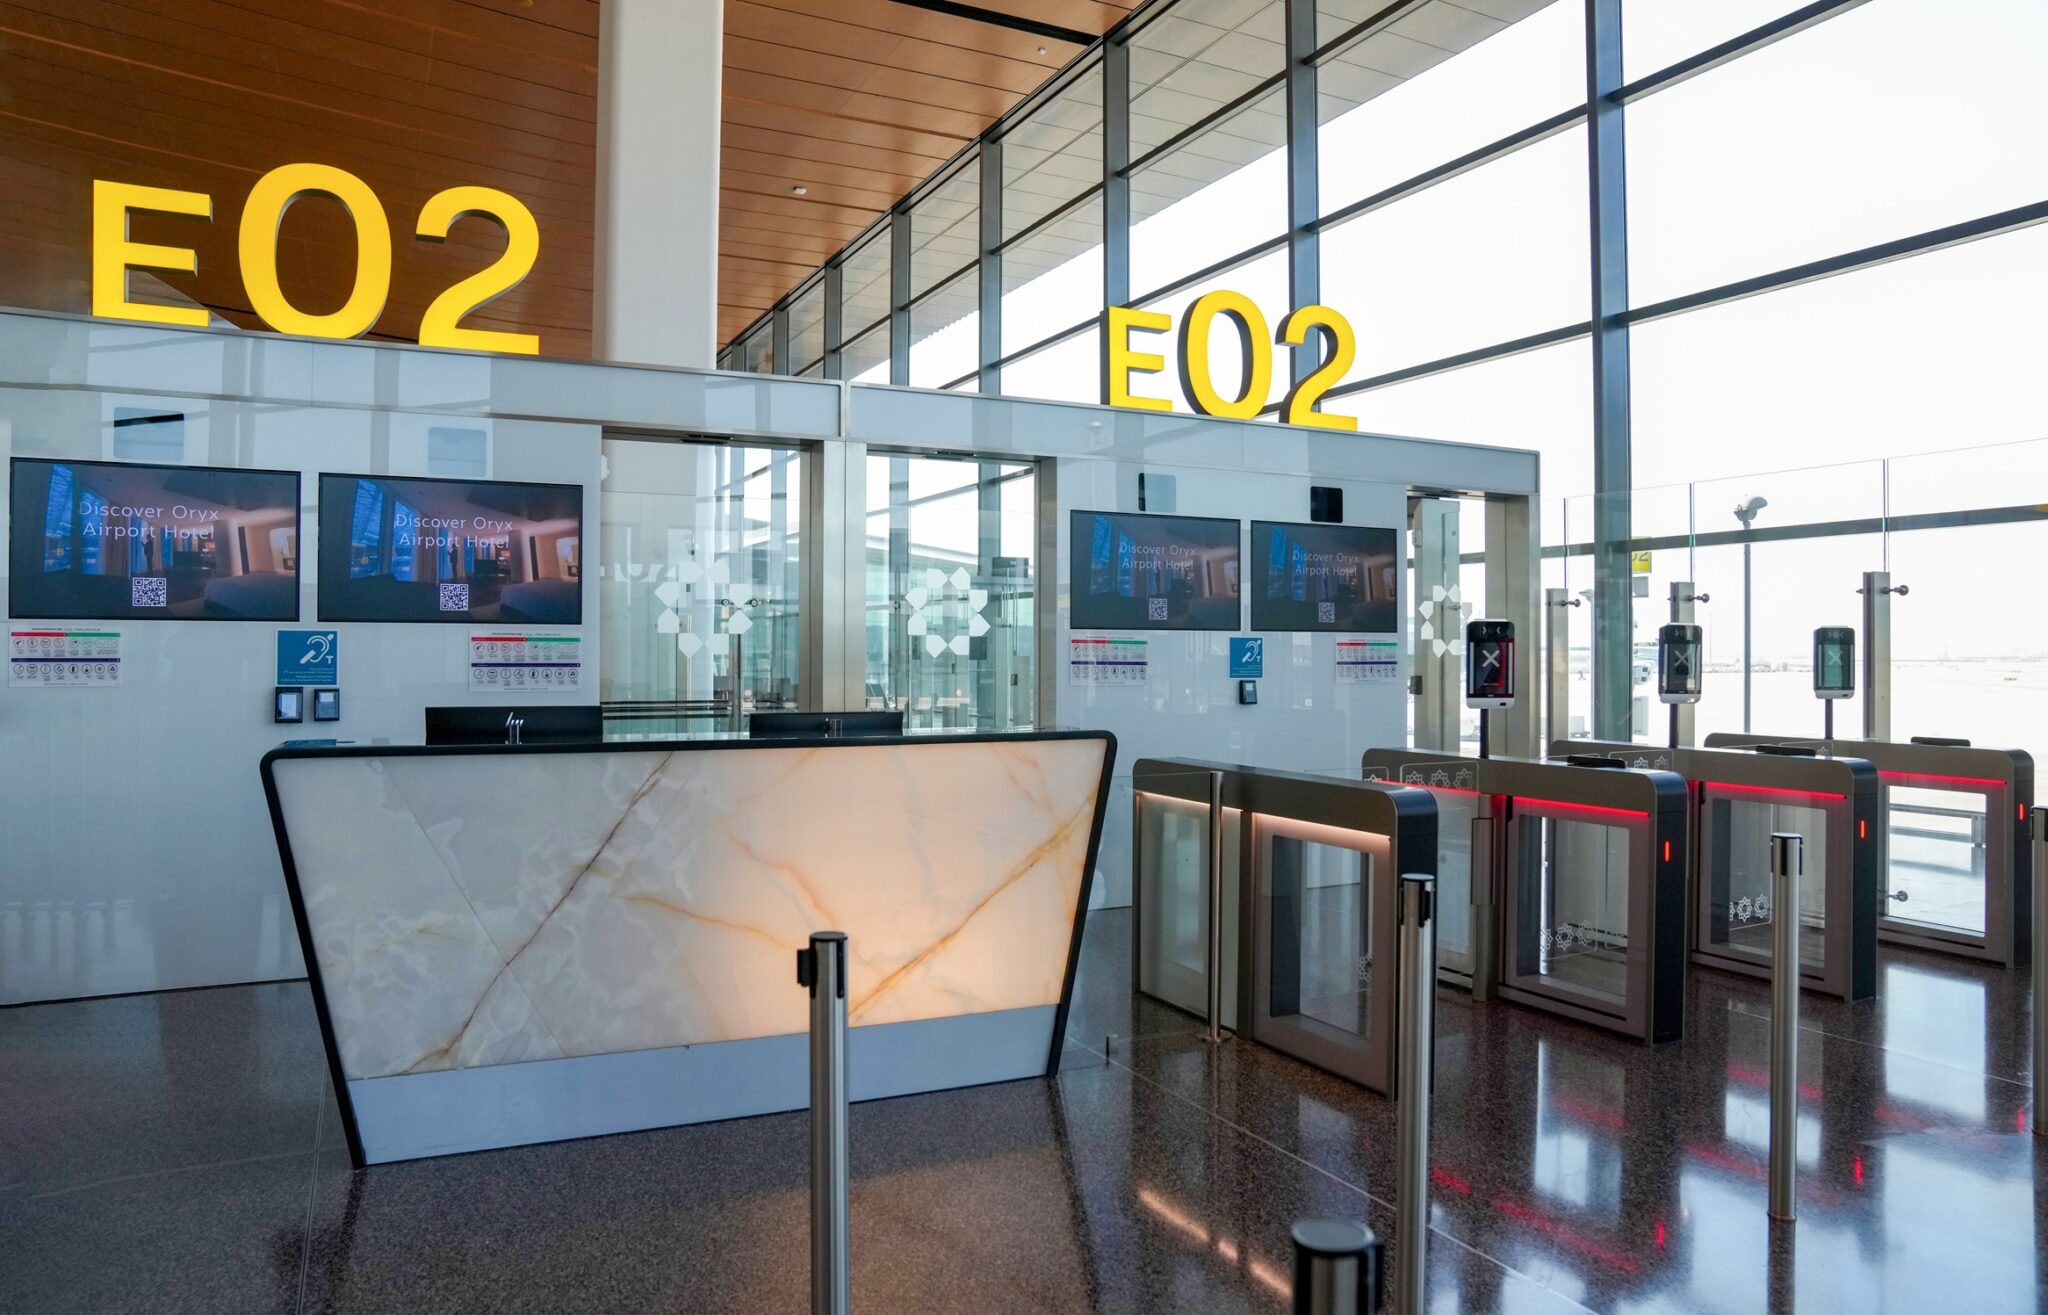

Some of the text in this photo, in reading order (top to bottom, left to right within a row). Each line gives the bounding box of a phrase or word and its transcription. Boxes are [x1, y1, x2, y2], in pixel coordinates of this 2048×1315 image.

[92, 163, 540, 356] E02
[1101, 289, 1358, 432] E02
[80, 502, 219, 523] Discover Oryx
[82, 522, 214, 540] Airport Hotel
[395, 513, 513, 533] Discover Oryx
[399, 533, 509, 549] Airport Hotel
[1119, 542, 1196, 558] Discover Oryx
[1293, 550, 1359, 564] Discover Oryx
[1122, 558, 1194, 571] Airport Hotel
[1295, 564, 1357, 577] Airport Hotel
